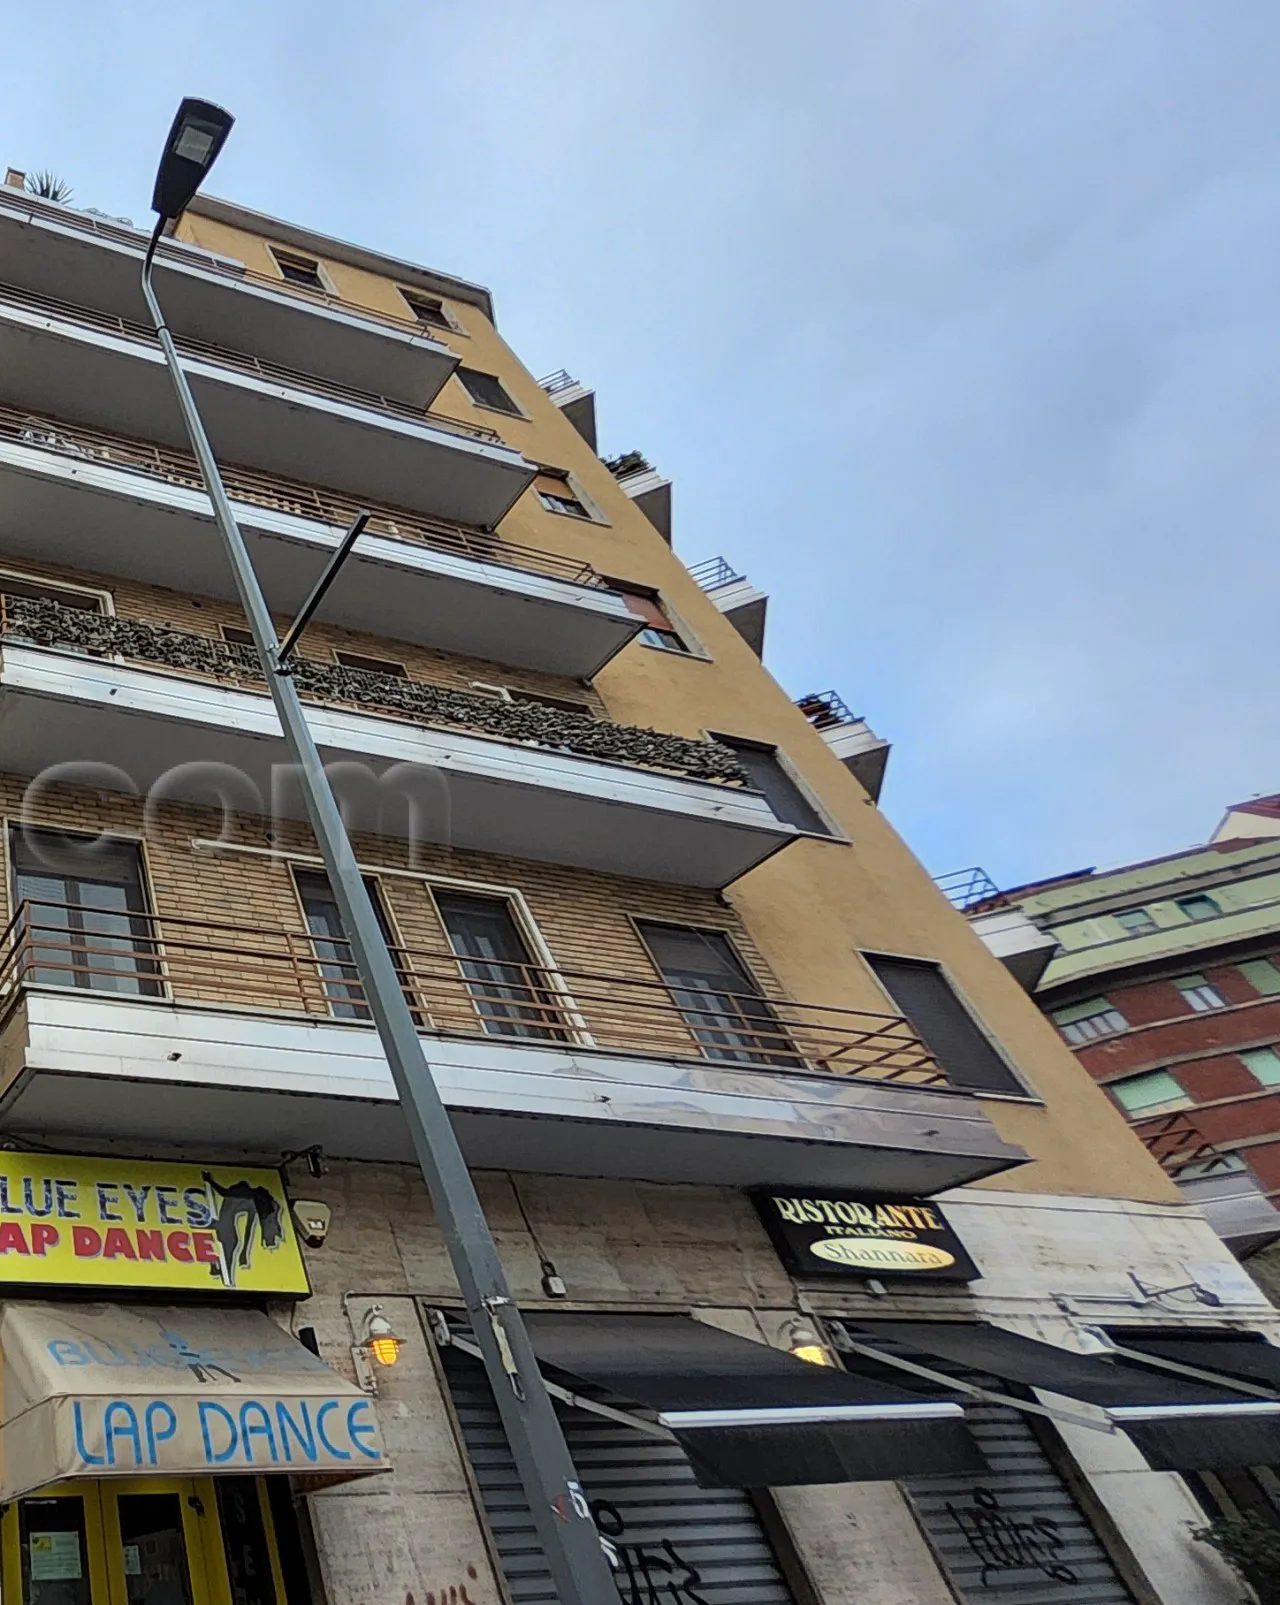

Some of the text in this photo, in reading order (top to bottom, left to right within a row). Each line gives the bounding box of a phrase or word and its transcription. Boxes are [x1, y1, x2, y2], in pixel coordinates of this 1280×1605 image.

[96, 1182, 214, 1227] EYES
[772, 1197, 945, 1231] RISTORANTE
[72, 1225, 221, 1264] DANCE
[824, 1225, 918, 1240] ITALIANO
[824, 1243, 942, 1265] Shannara
[72, 1400, 381, 1465] LAP DANCE
